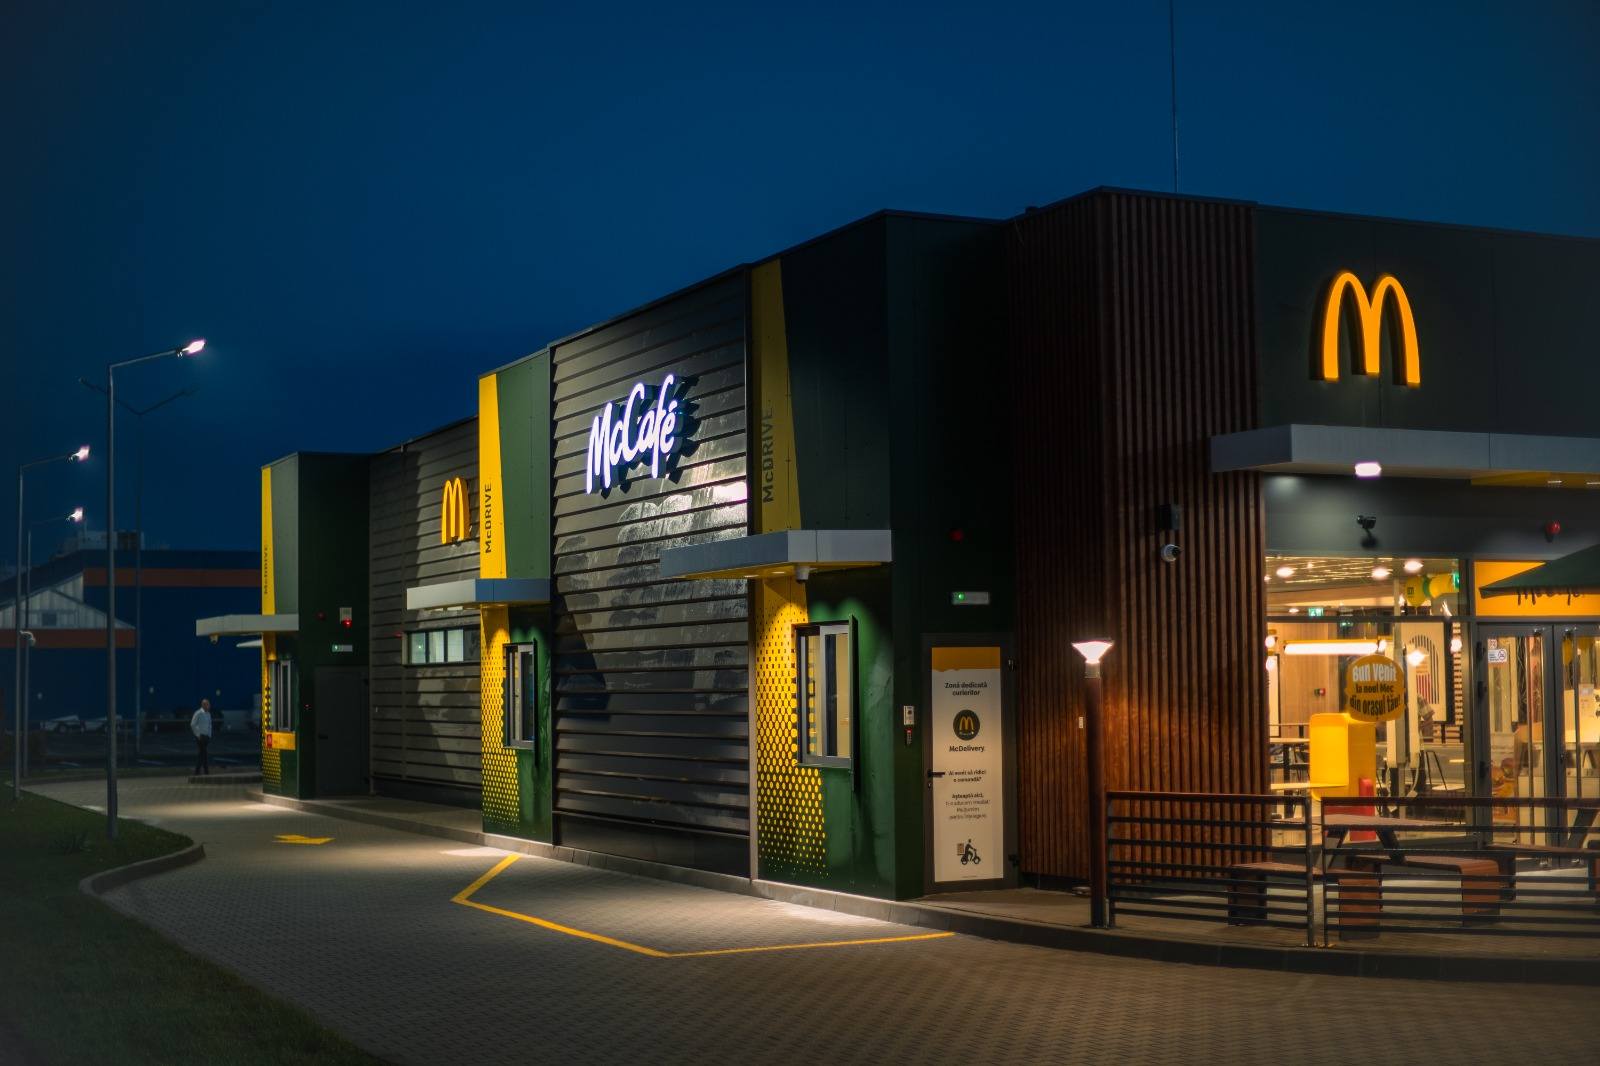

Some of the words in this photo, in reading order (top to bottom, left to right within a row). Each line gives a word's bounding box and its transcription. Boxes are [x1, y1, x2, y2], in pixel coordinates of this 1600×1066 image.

[586, 374, 678, 495] McCafé
[762, 408, 774, 503] McDRIVE
[484, 483, 492, 554] McDRIVE
[1350, 694, 1361, 712] din
